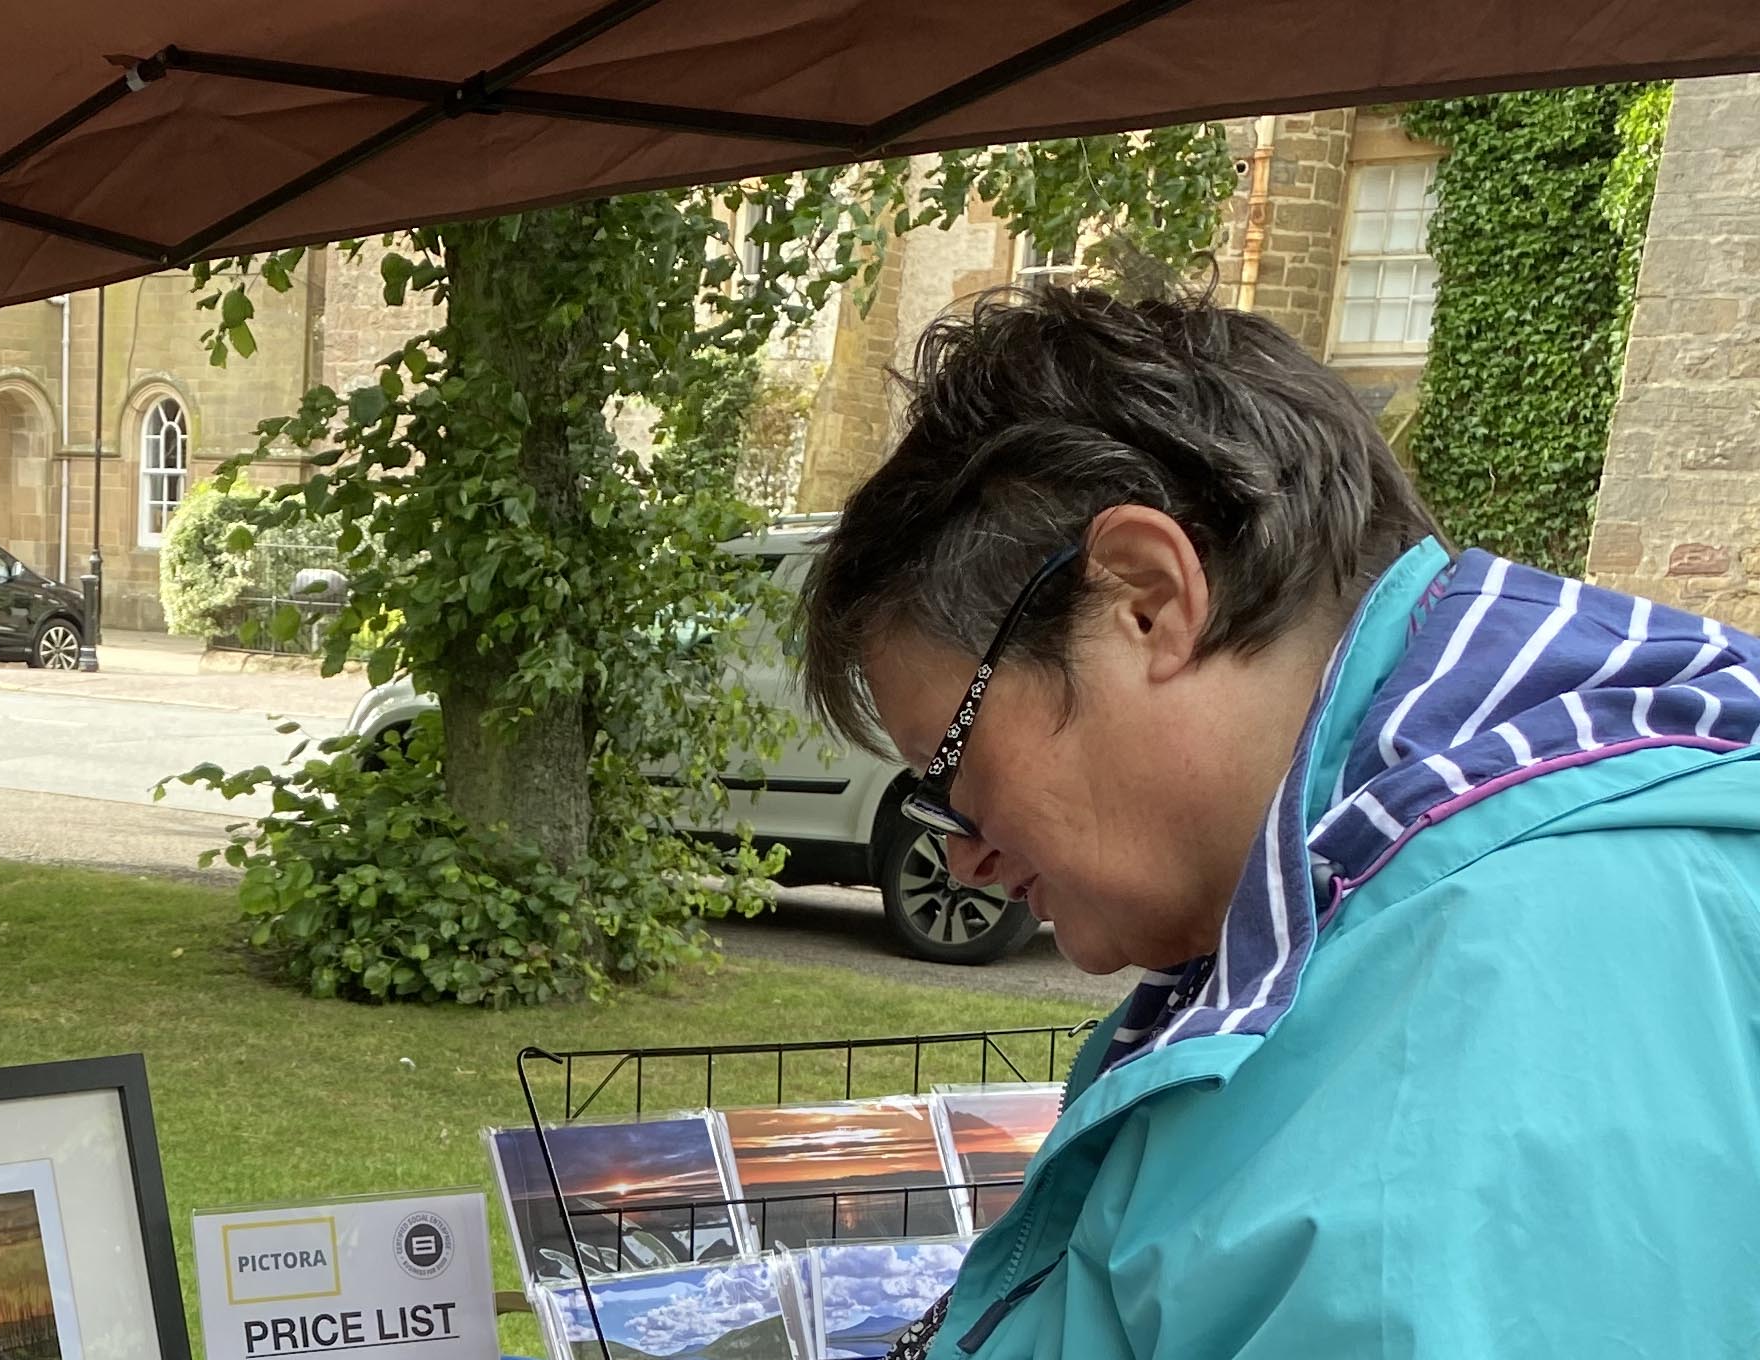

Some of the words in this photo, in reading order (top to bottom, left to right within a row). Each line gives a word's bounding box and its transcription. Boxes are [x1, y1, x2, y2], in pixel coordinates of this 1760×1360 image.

[238, 1249, 328, 1273] PICTORA
[244, 1311, 365, 1353] PRICE
[376, 1302, 456, 1342] LIST
